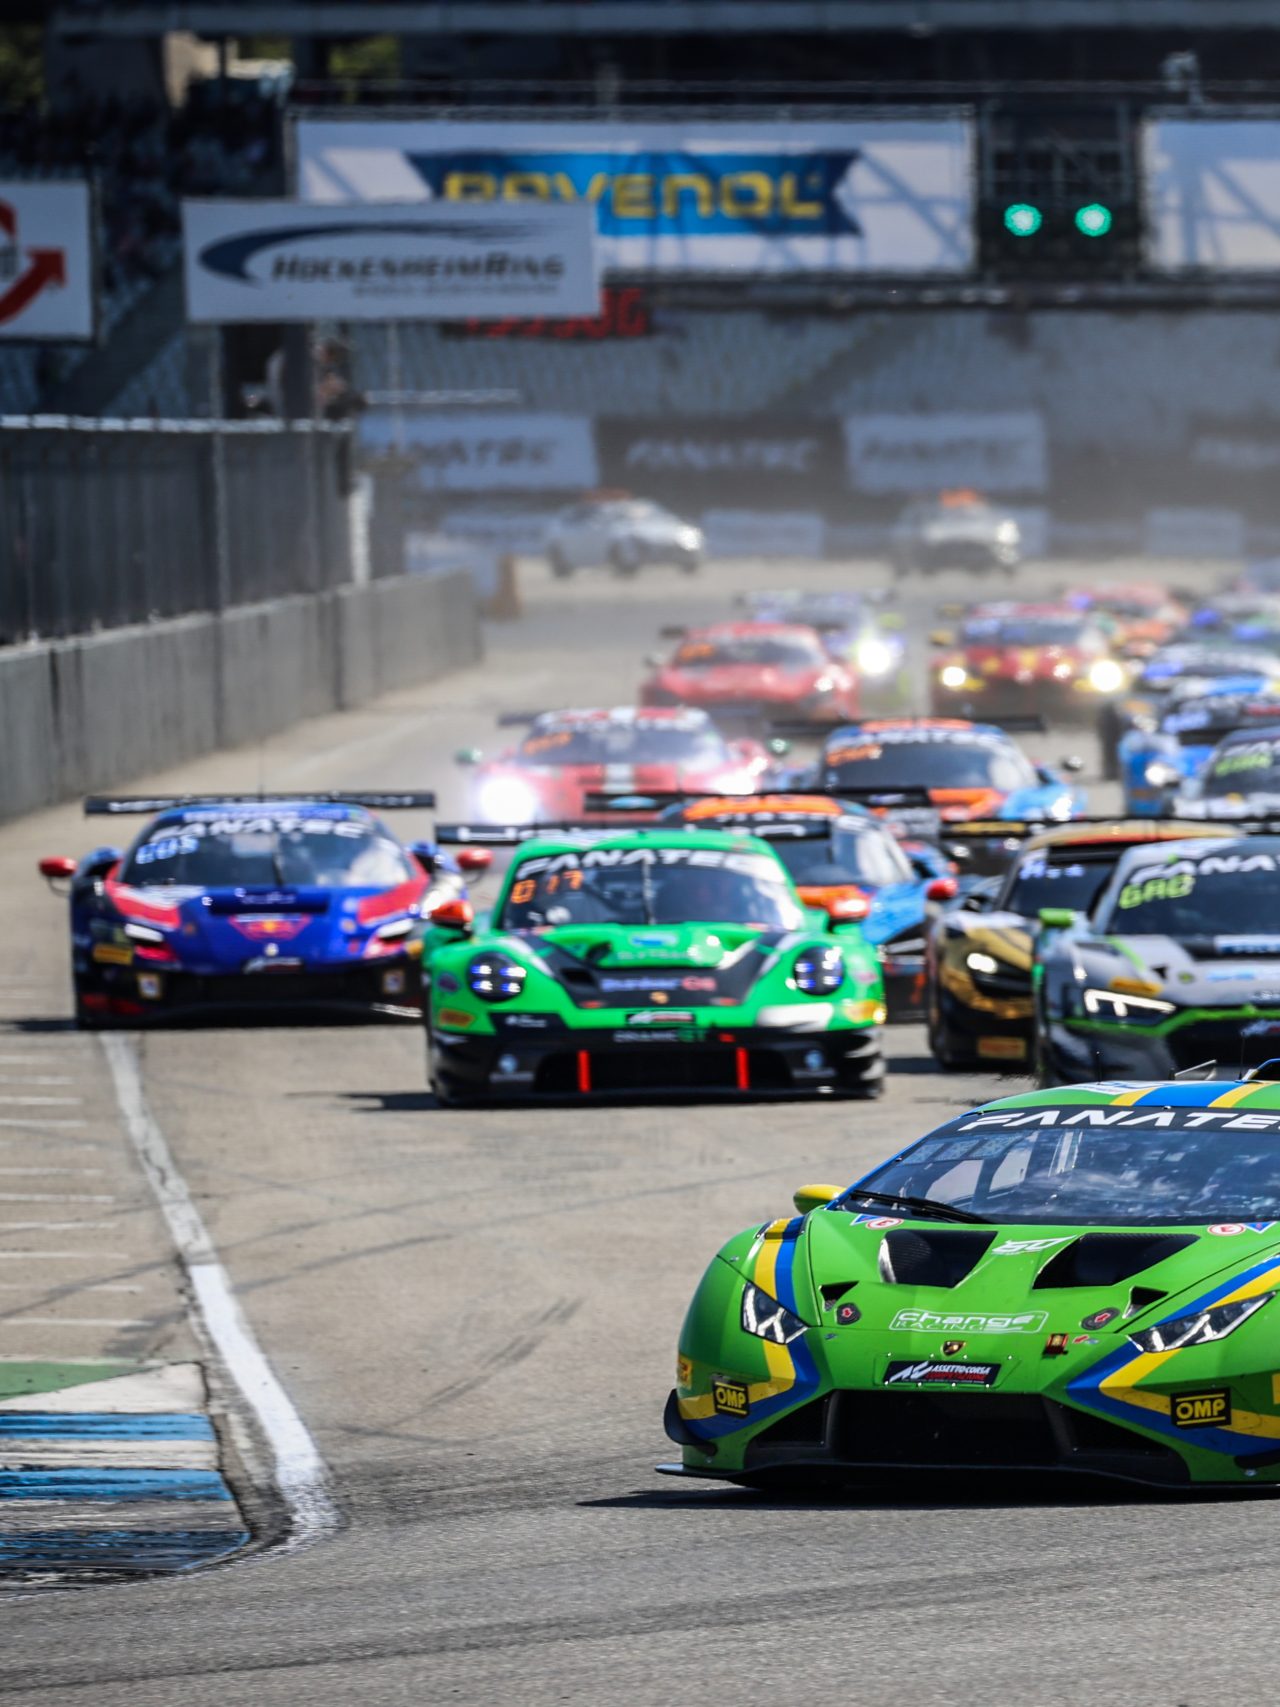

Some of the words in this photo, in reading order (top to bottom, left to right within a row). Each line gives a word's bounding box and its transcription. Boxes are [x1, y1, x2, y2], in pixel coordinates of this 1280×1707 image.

[149, 817, 374, 842] FANATEC
[517, 848, 770, 878] FANATEC
[715, 1386, 746, 1409] OMP
[1175, 1397, 1227, 1421] OMP
